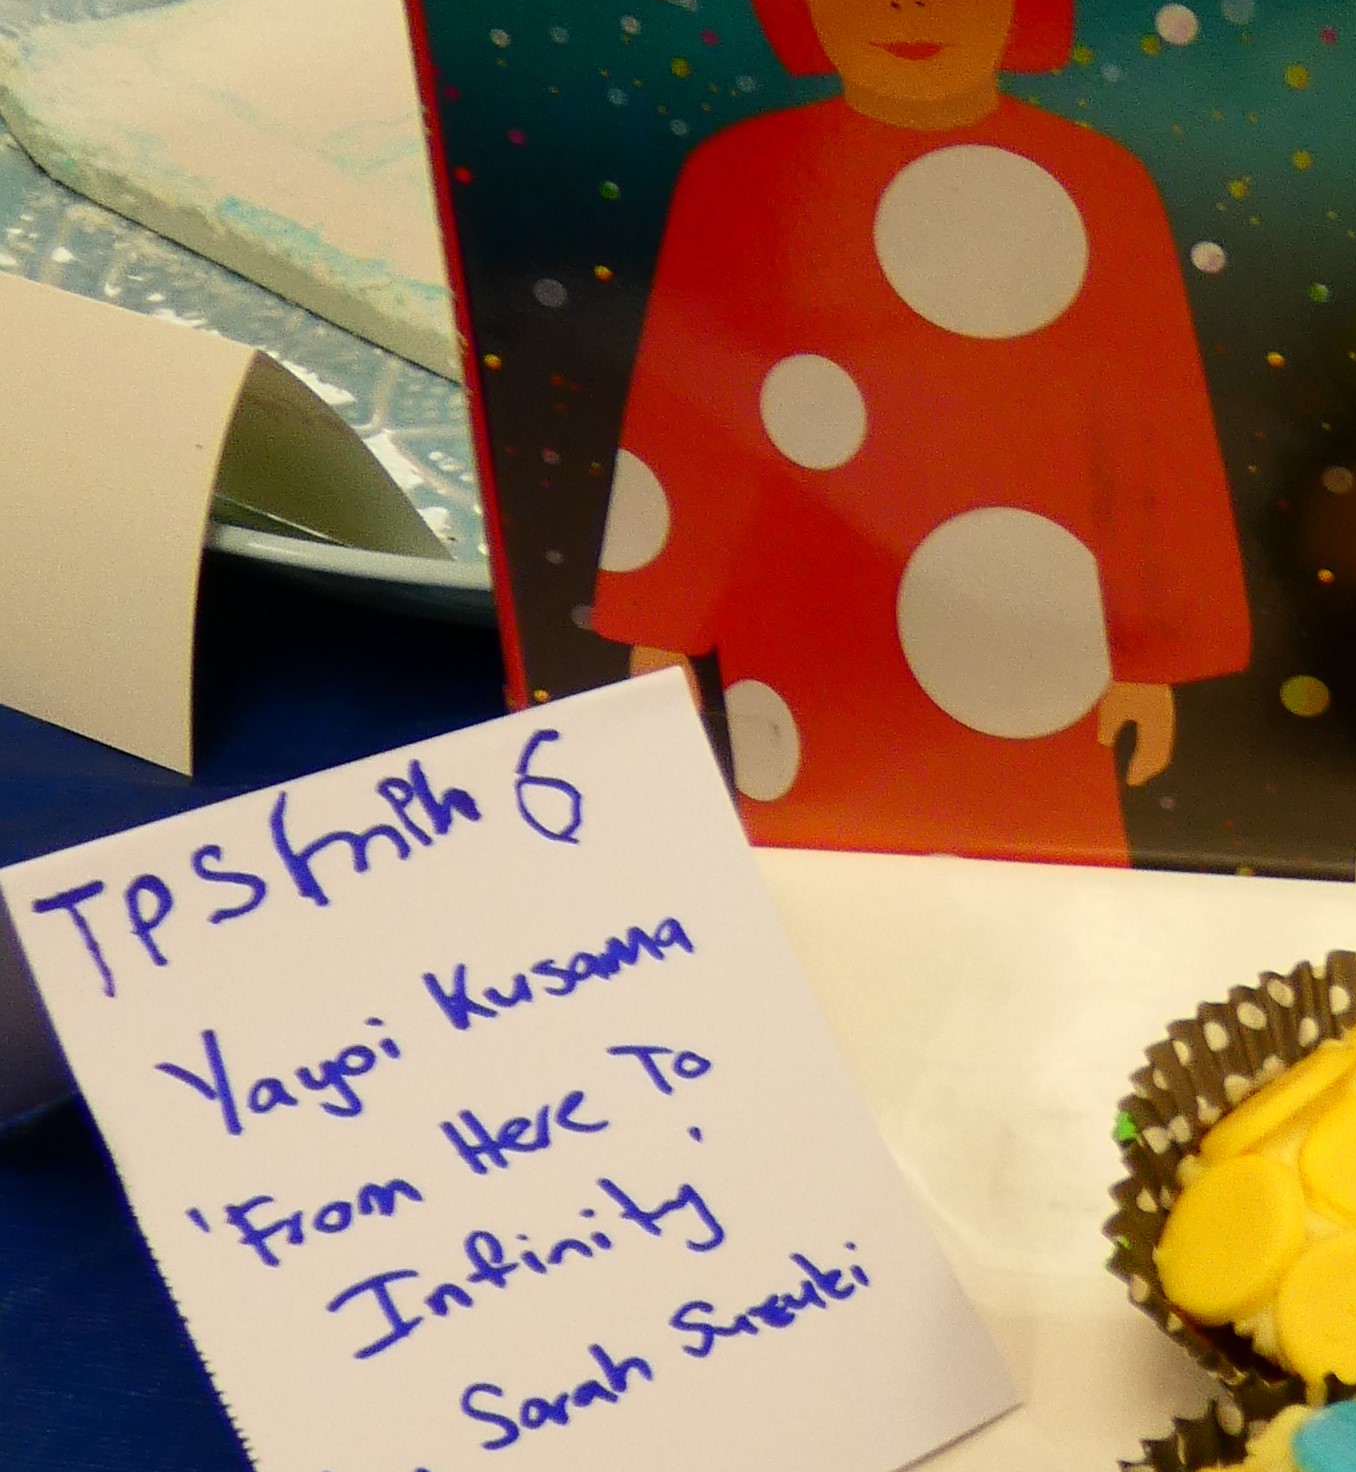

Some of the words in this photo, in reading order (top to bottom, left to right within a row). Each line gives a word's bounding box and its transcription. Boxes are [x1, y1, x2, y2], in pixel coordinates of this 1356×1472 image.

[514, 729, 582, 844] 6
[154, 1016, 401, 1135] Yayoi
[421, 917, 695, 1030] Kusama
[439, 1090, 610, 1174] Here
[606, 1044, 713, 1095] To
[459, 1342, 655, 1451] Sarah
